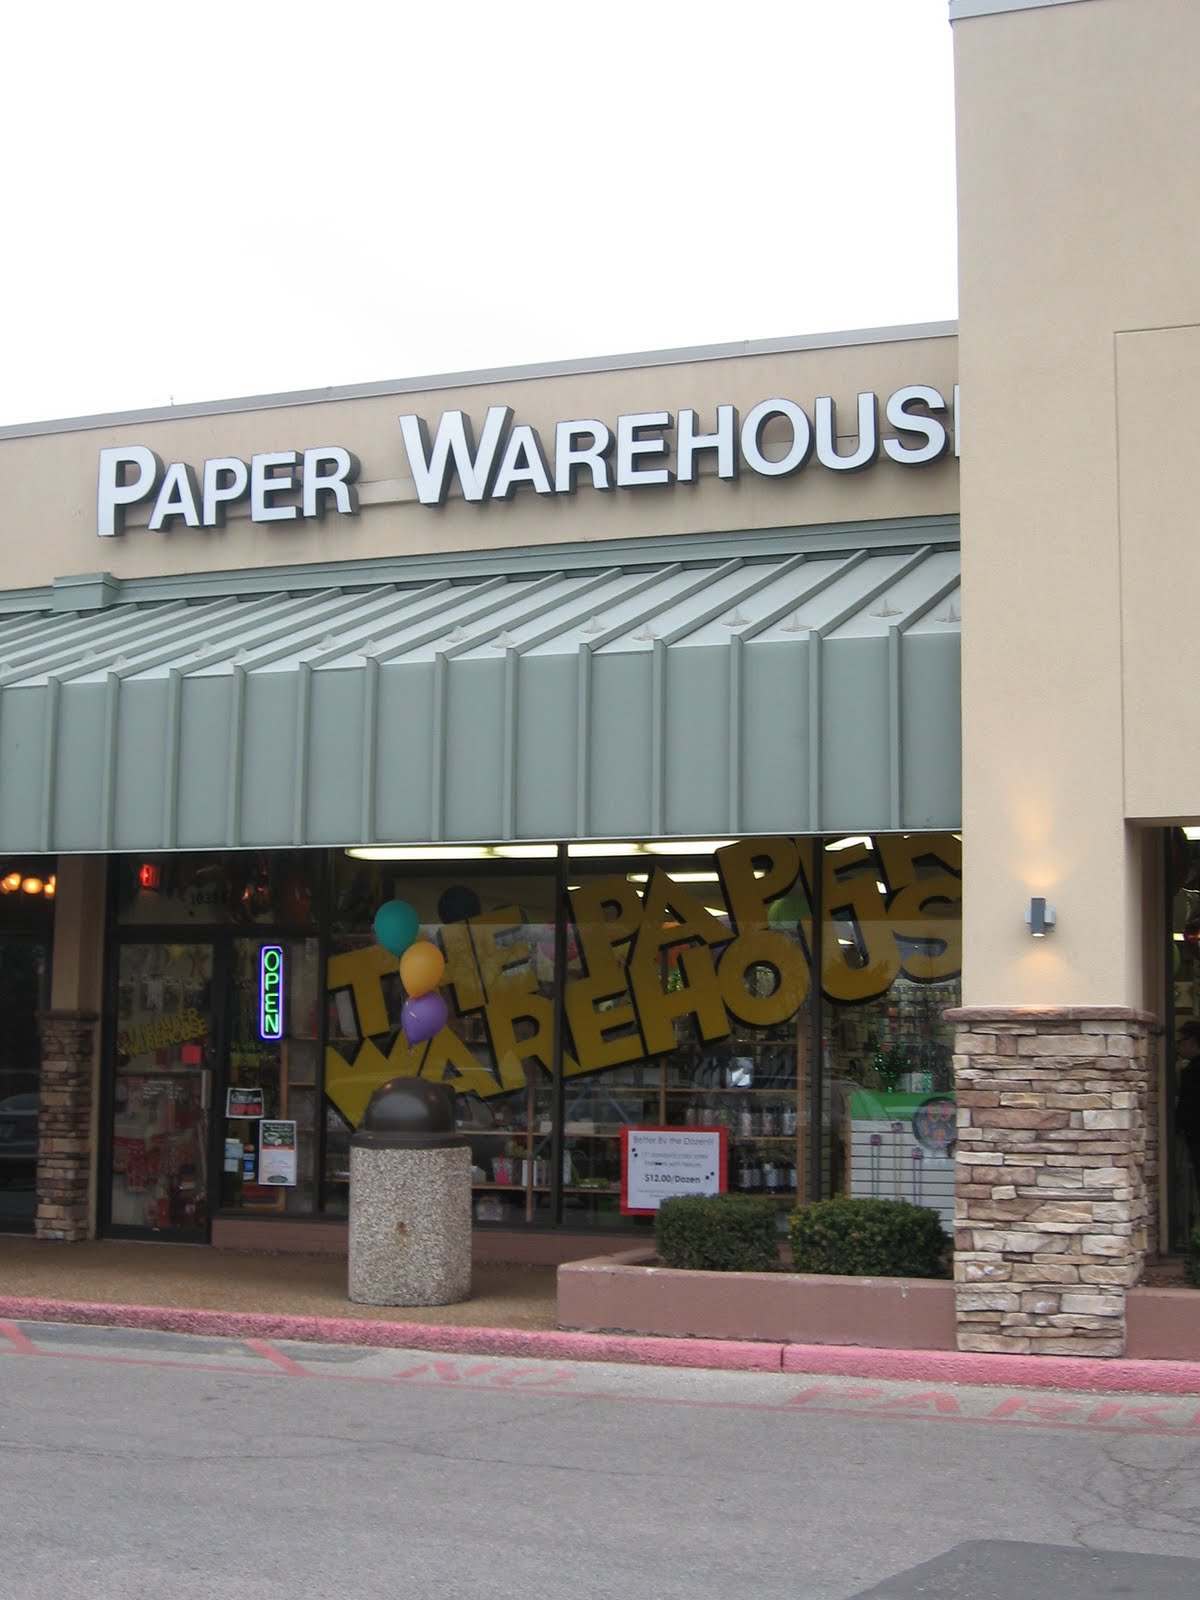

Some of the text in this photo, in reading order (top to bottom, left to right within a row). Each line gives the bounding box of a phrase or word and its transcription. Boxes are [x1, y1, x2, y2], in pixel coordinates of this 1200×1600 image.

[97, 384, 960, 537] PAPER WAREHOUS
[263, 949, 280, 1034] OPEN
[633, 1136, 656, 1144] Better
[658, 1137, 667, 1145] By
[670, 1137, 682, 1145] the
[644, 1174, 701, 1184] $12.00/Dozen
[393, 1361, 577, 1385] NO
